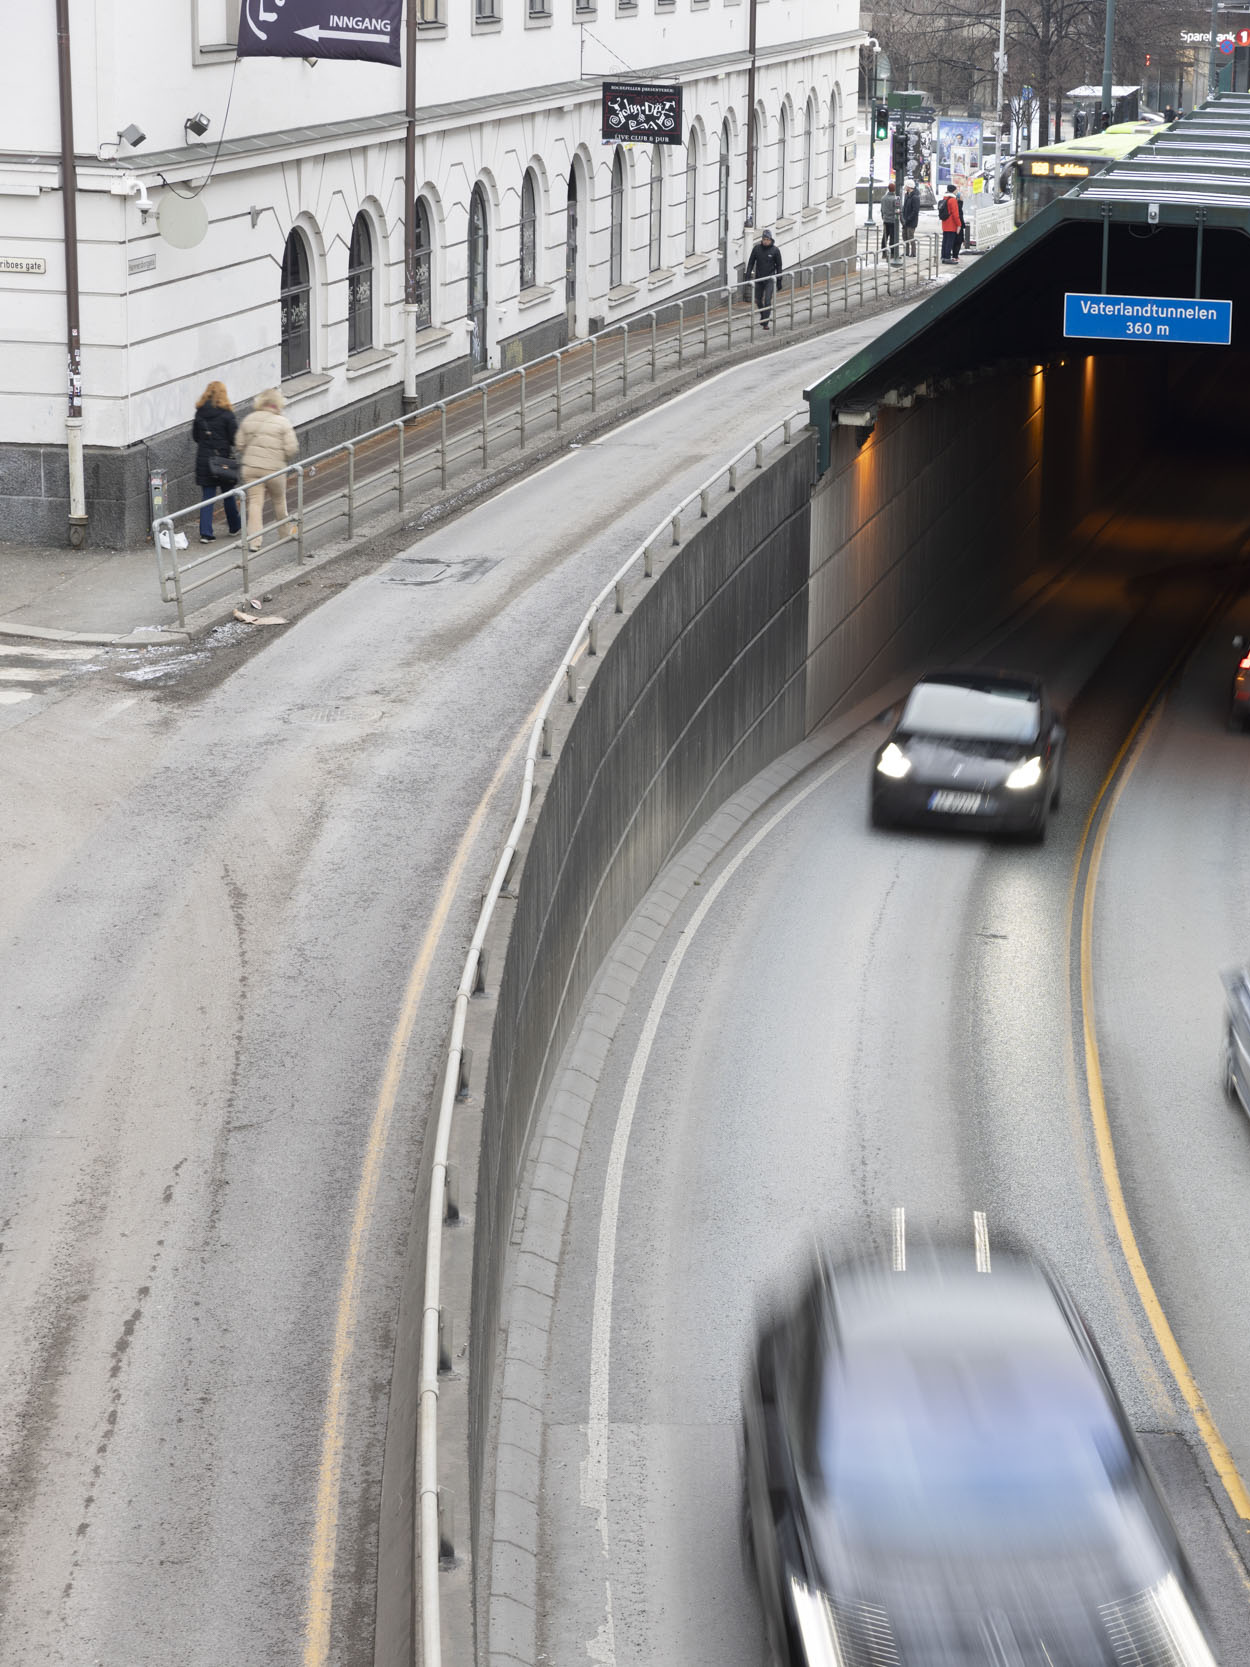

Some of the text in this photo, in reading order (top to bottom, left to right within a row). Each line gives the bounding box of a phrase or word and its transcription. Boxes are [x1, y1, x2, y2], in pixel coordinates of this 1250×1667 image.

[329, 15, 391, 32] INNGANG
[25, 261, 42, 272] gate
[1080, 300, 1217, 320] Vaterlandtunnelen
[1126, 322, 1169, 336] 360 m
